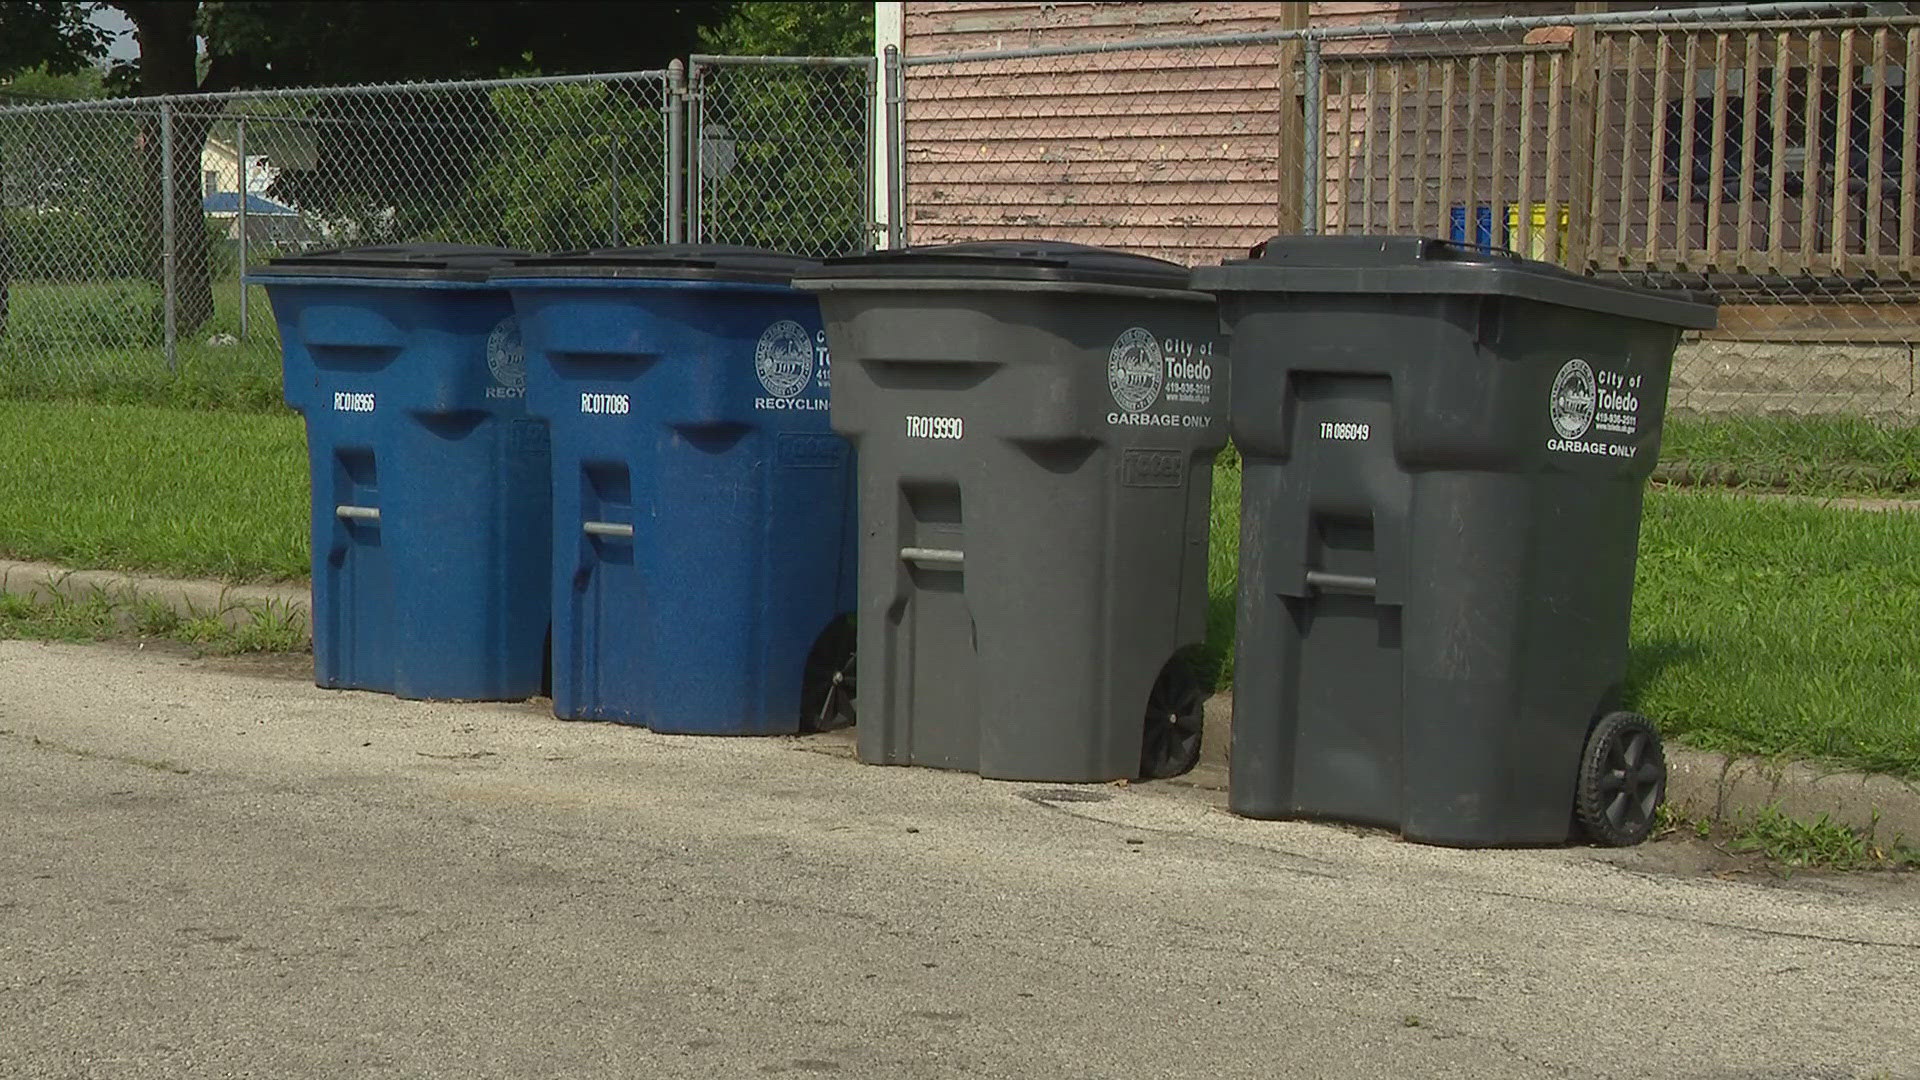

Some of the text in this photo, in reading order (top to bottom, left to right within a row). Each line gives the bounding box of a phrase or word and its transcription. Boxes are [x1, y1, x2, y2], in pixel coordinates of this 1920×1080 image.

[1164, 338, 1213, 358] City of
[1164, 357, 1212, 380] Toledo
[1598, 370, 1642, 389] City of
[581, 393, 629, 414] RC017086
[755, 397, 831, 411] RECYCLIN
[1597, 389, 1638, 412] Toledo
[906, 416, 963, 439] TR019990
[1107, 412, 1212, 428] GARBAGE ONLY
[1320, 423, 1370, 440] TR086049
[1547, 439, 1637, 459] GARBAGE ONLY
